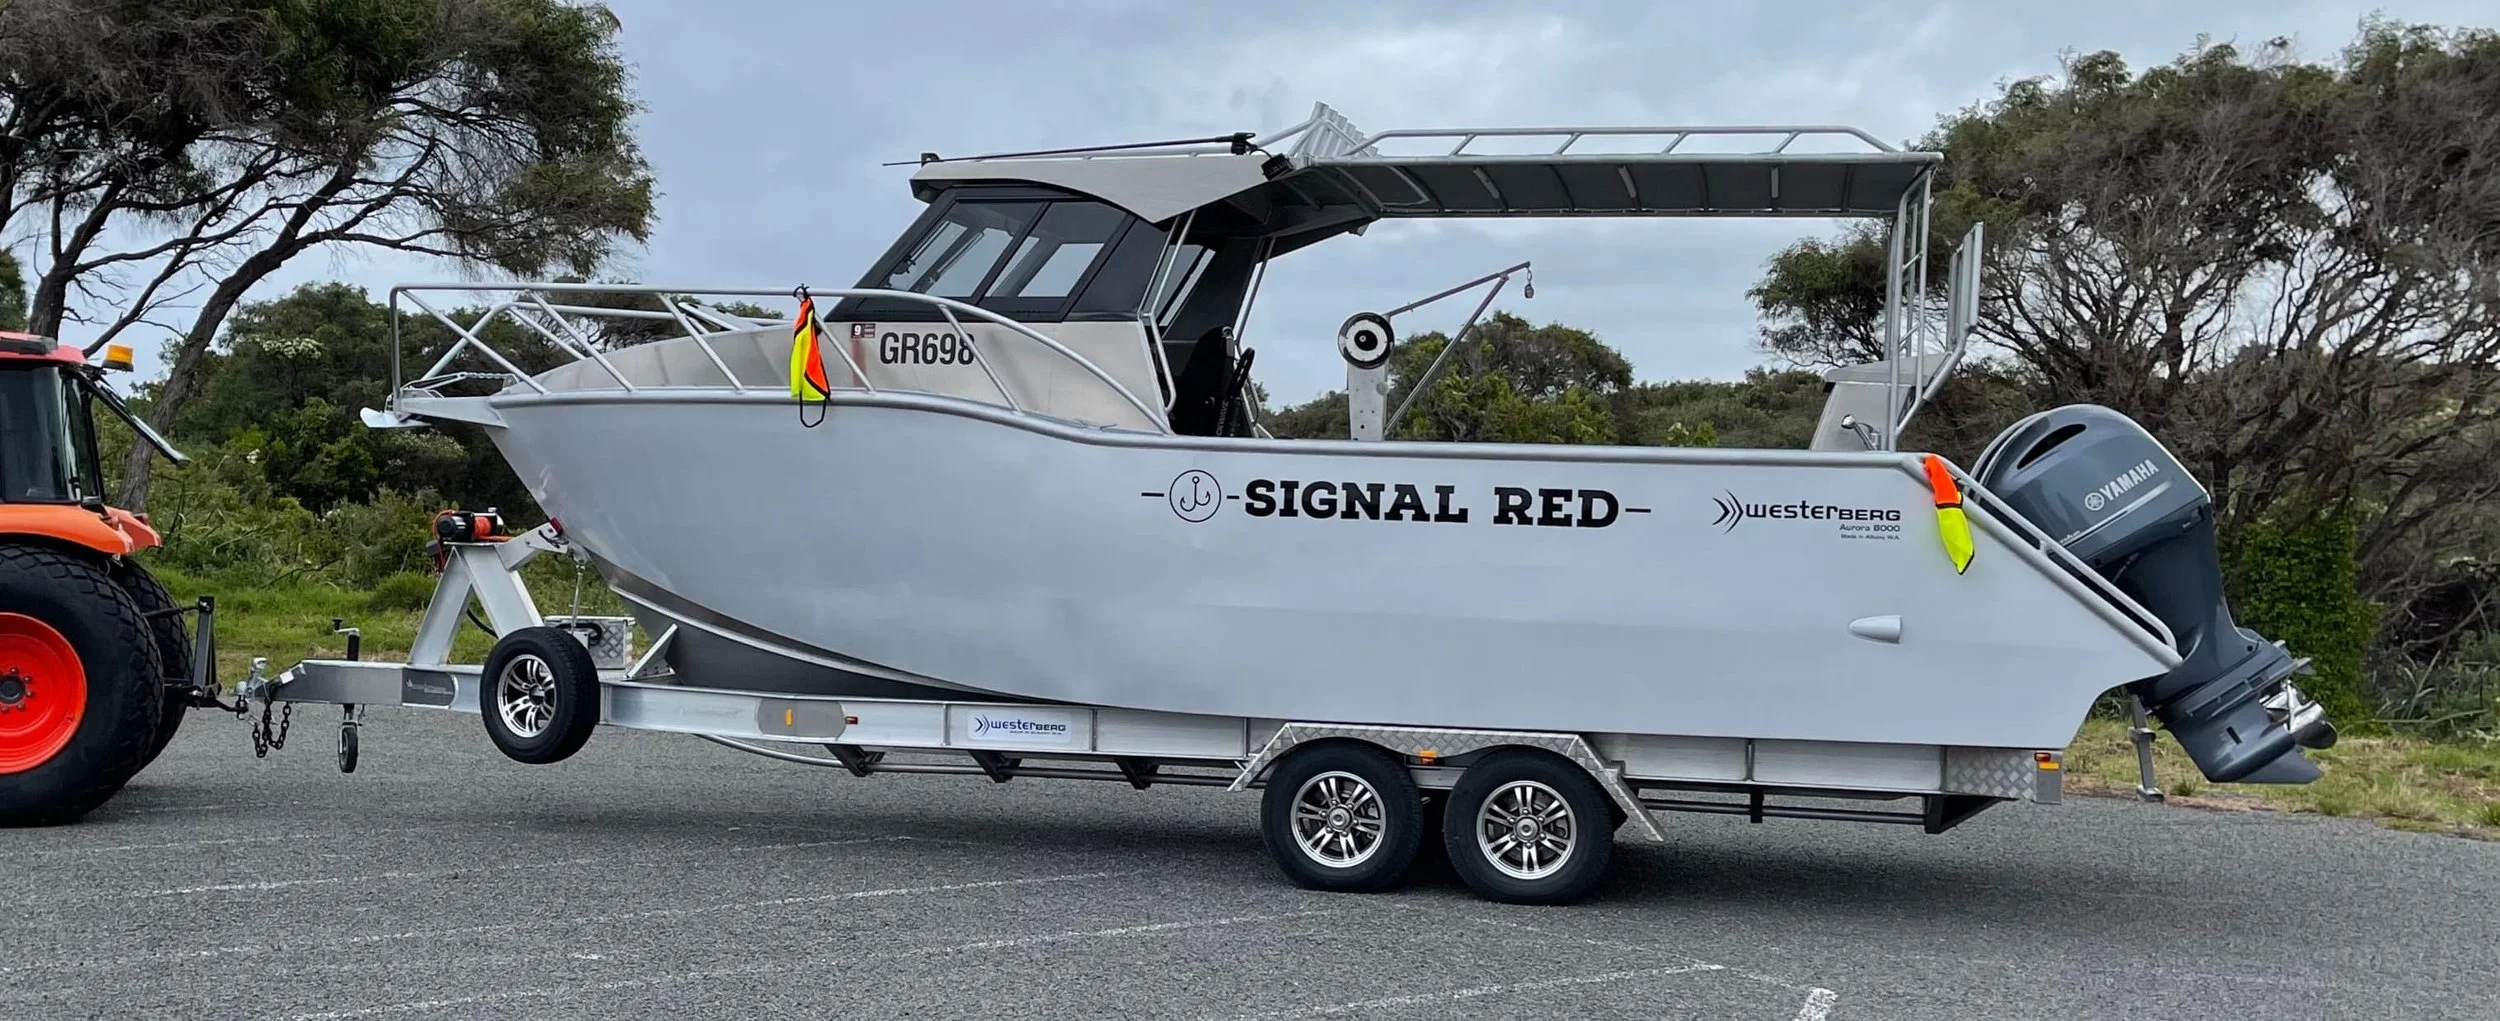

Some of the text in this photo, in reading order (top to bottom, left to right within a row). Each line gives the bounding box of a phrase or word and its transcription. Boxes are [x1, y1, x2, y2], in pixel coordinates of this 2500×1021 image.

[854, 325, 862, 336] 9
[880, 332, 975, 365] GR698
[2099, 459, 2160, 501] YAMAHA
[1245, 479, 1619, 528] SIGNAL RED
[1840, 523, 1901, 532] Aurora 8000
